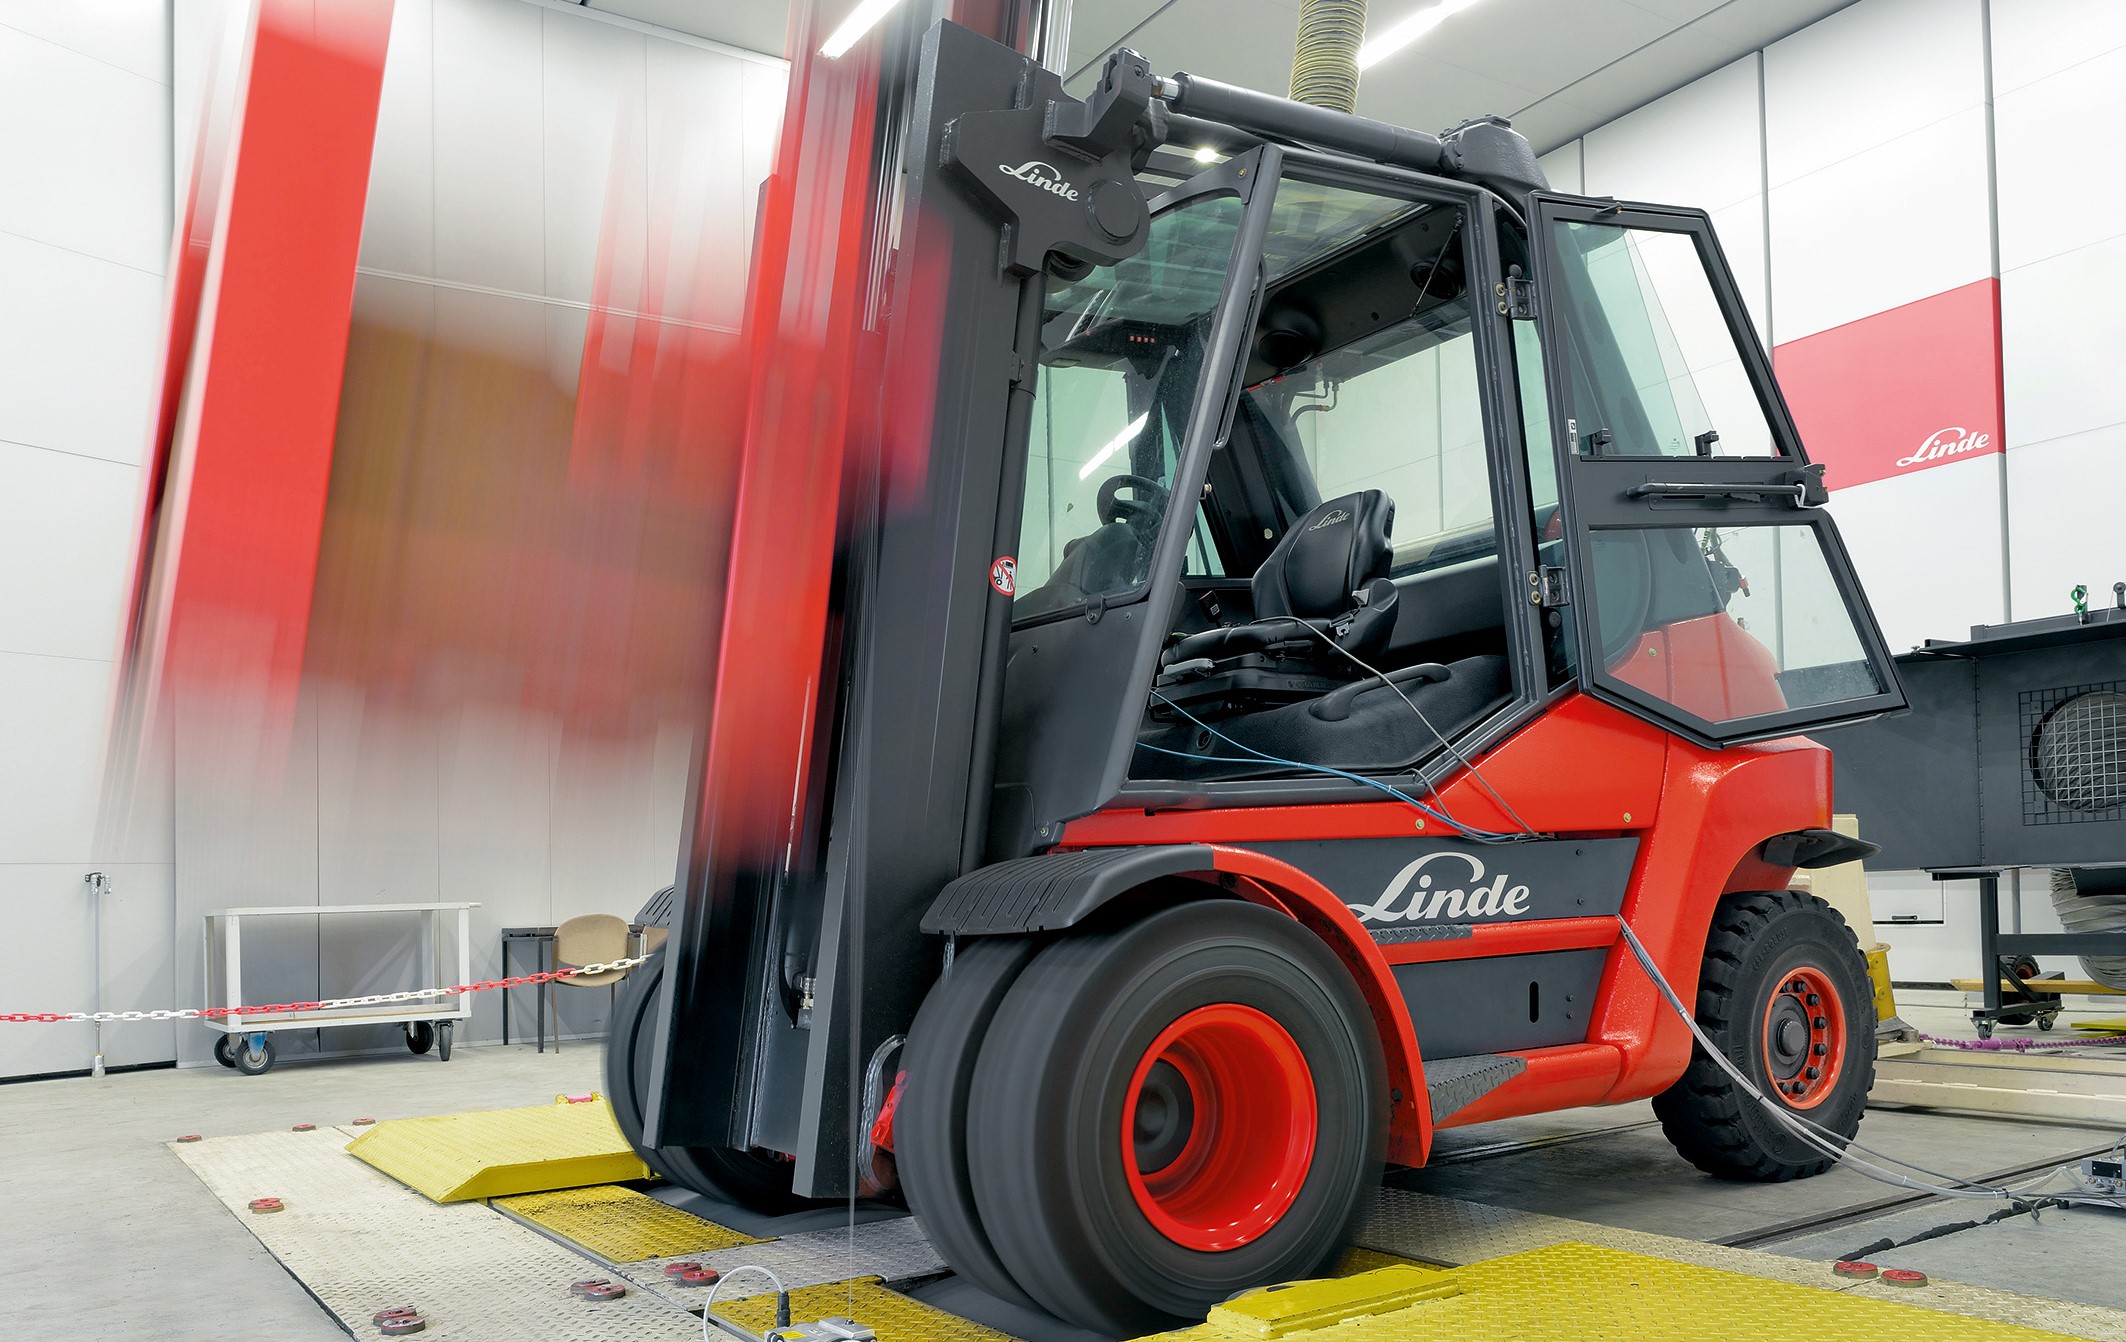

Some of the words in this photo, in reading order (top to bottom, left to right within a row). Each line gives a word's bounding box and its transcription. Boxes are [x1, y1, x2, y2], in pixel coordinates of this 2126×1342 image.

[998, 161, 1079, 202] Linde
[1896, 426, 1989, 467] Linde
[1308, 509, 1350, 532] Linde
[1347, 851, 1530, 922] Linde
